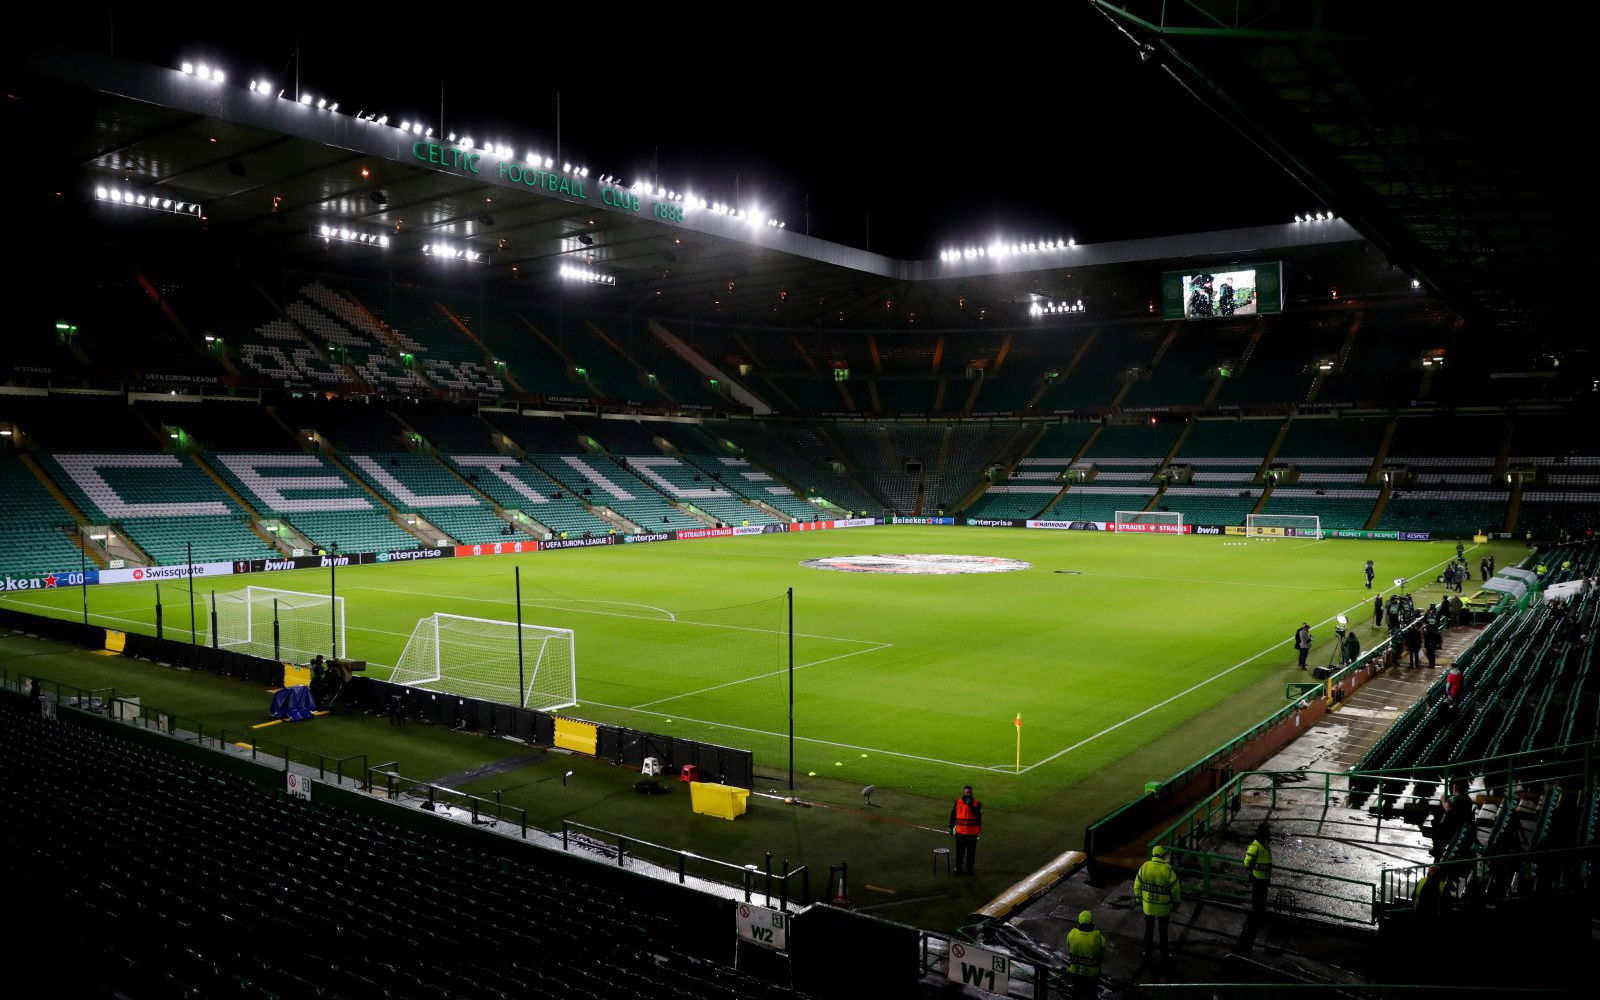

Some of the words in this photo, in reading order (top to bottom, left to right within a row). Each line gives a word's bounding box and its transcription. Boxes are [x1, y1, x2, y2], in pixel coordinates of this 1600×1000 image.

[412, 139, 481, 173] CELTIC
[500, 161, 587, 199] FOOTBALL
[601, 186, 641, 212] CLUB
[653, 199, 684, 223] 1888
[165, 374, 191, 383] EUROPA
[192, 375, 218, 384] LEAGUE
[52, 454, 731, 518] CELTIC
[892, 516, 926, 524] Heineken
[969, 518, 1013, 527] enterprise
[684, 530, 706, 539] STRAUSS
[711, 528, 732, 537] STRAUSS
[1197, 525, 1220, 534] bwin
[545, 539, 561, 549] UEFA
[562, 538, 584, 548] EUROPA
[585, 537, 607, 546] LEAGUE
[626, 532, 668, 543] enterprise
[320, 553, 349, 567] bwin
[377, 547, 442, 562] enterprise
[264, 557, 295, 571] bwin
[145, 564, 204, 580] Swissquote
[751, 924, 773, 944] W2
[961, 962, 996, 992] W1
